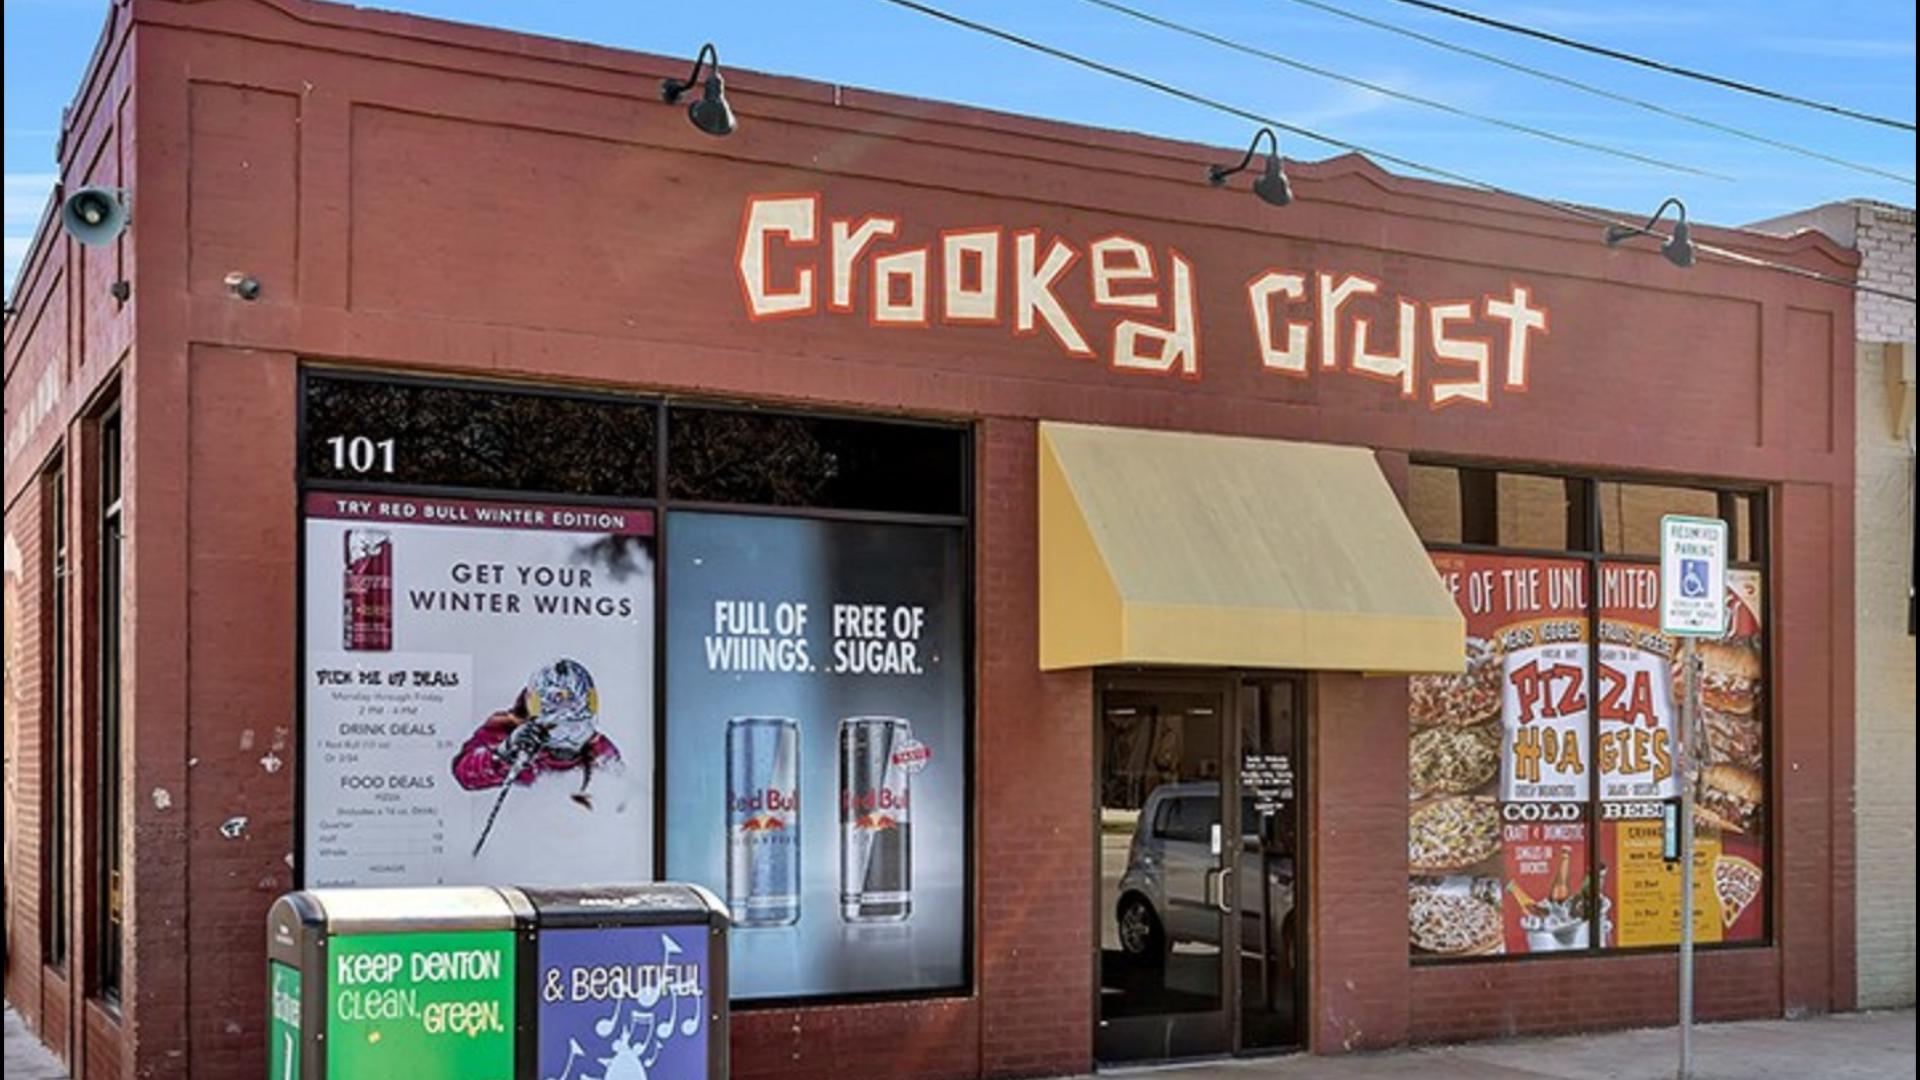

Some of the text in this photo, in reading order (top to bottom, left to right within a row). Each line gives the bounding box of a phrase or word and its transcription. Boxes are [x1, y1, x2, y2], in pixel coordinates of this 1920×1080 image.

[327, 435, 395, 472] 101
[336, 500, 625, 529] TRY RED BULL WINTER EDITION
[452, 564, 592, 587] GET YOUR
[1469, 569, 1496, 613] OF
[1502, 568, 1541, 612] THE
[409, 590, 633, 617] WINTER WINGS
[715, 601, 808, 636] FULL OF
[833, 604, 925, 640] FREE OF
[705, 635, 816, 673] WIIINGS.
[834, 640, 924, 674] SUGAR.
[359, 670, 382, 685] ME
[388, 670, 407, 687] UP
[413, 671, 459, 687] DEALS
[1510, 659, 1659, 729] PIZZA
[339, 723, 436, 736] DRINK DEALS
[1513, 726, 1673, 784] HOAGIES
[341, 776, 435, 789] FOOD DEALS
[1503, 803, 1580, 821] COLD
[544, 967, 565, 1001] &
